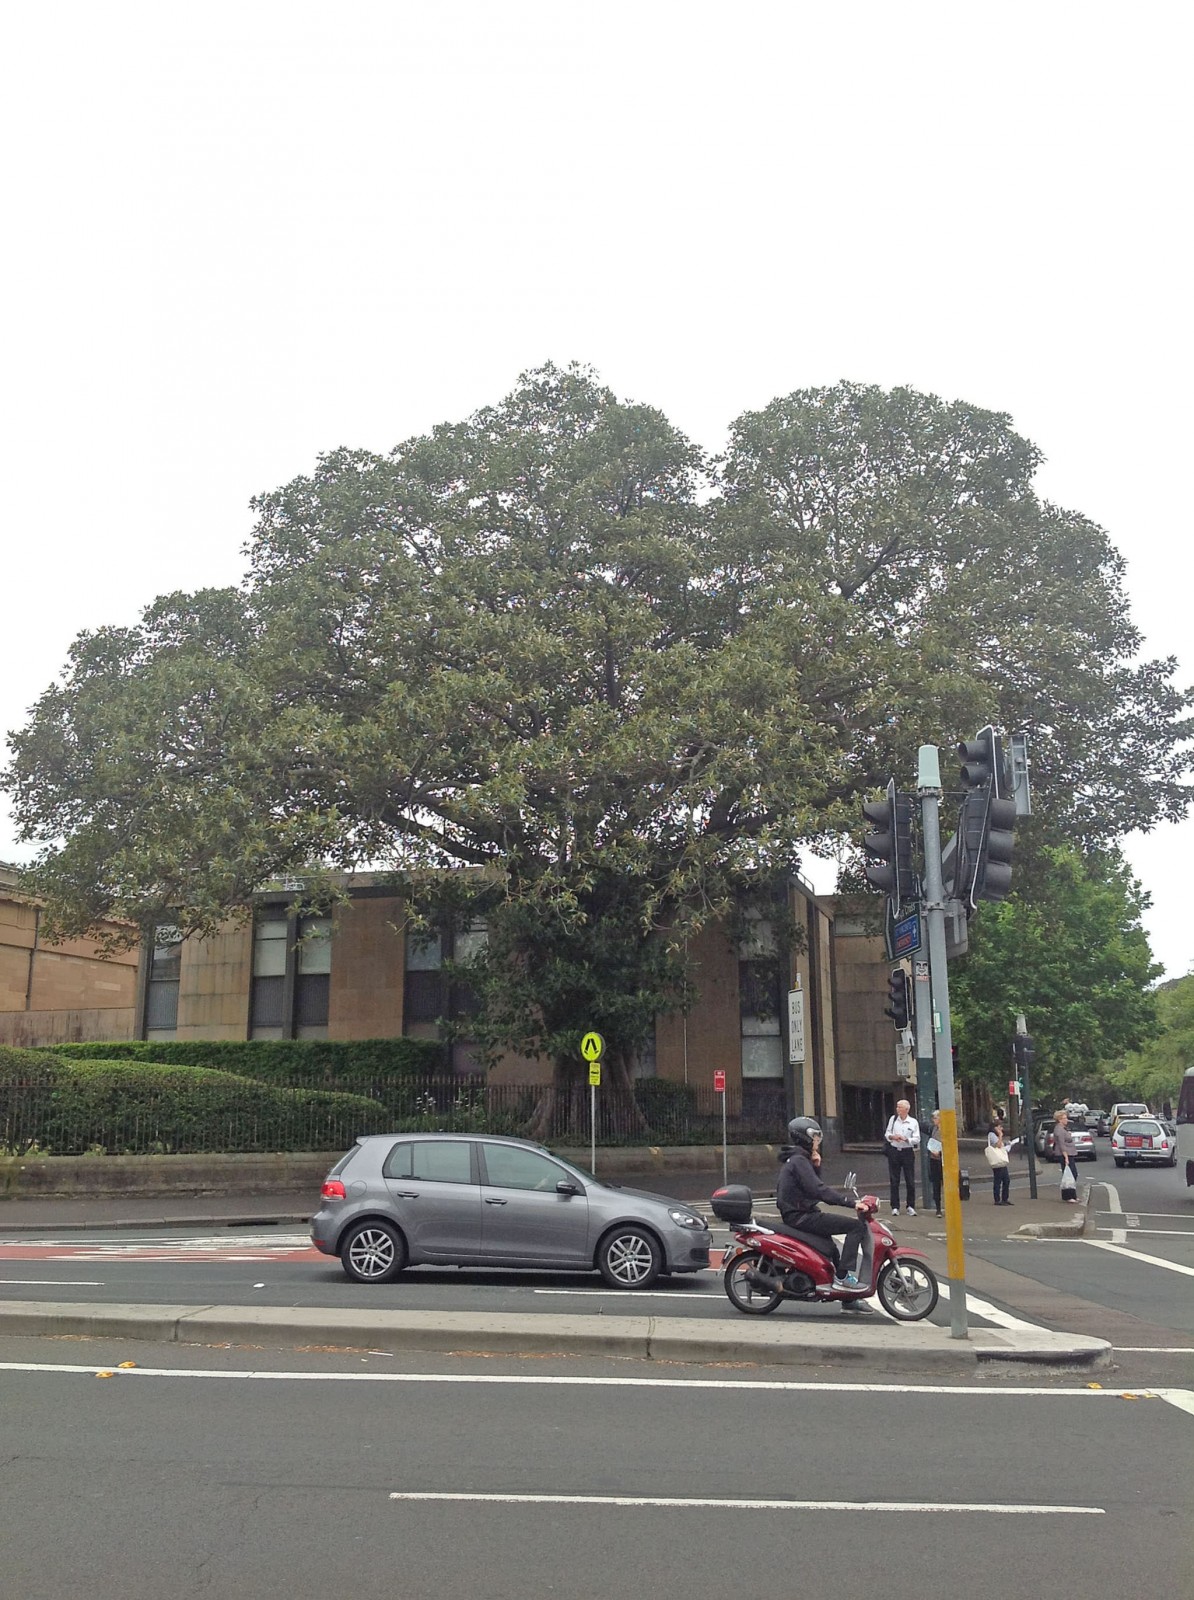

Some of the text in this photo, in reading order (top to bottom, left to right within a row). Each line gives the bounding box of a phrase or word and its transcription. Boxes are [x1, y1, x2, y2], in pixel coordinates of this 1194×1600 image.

[791, 1001, 801, 1014] BUS
[791, 1019, 802, 1033] ONLY
[791, 1037, 803, 1052] LANE
